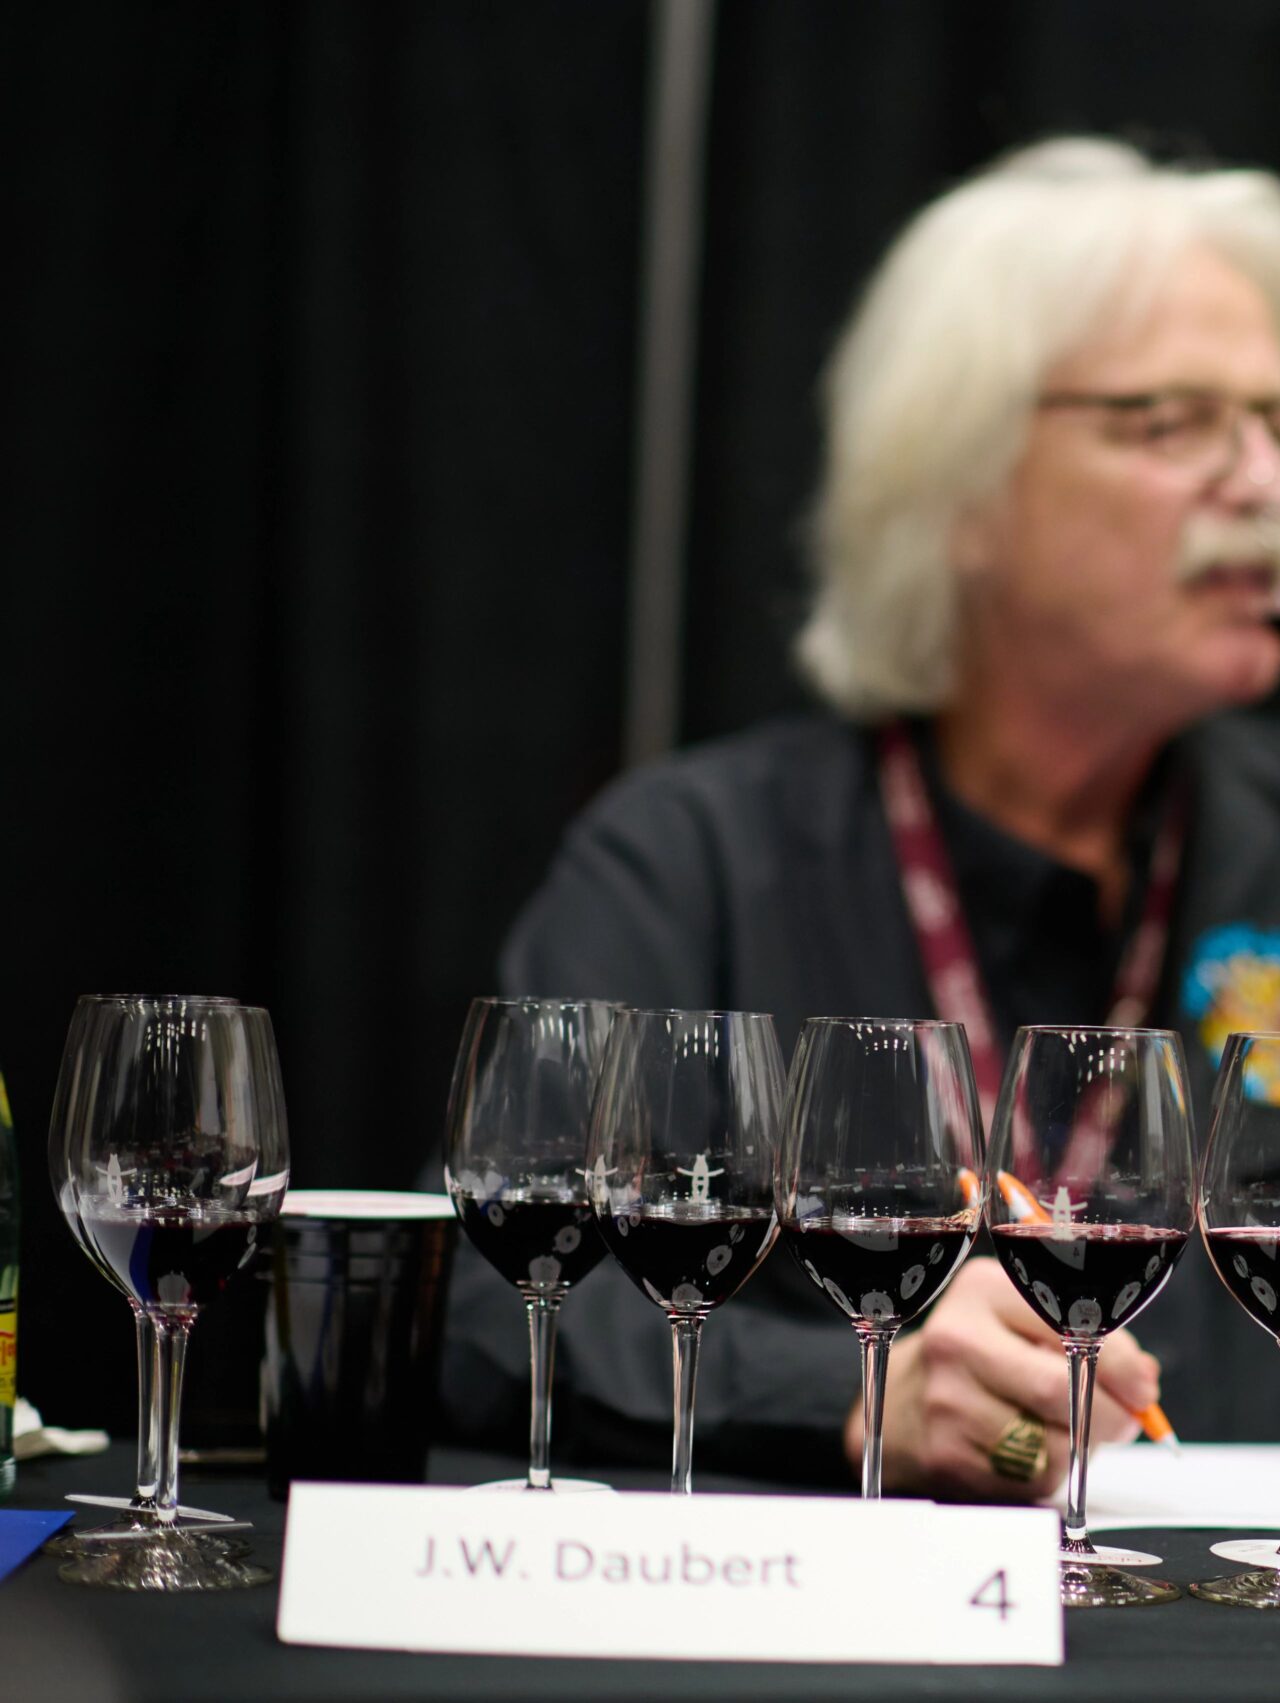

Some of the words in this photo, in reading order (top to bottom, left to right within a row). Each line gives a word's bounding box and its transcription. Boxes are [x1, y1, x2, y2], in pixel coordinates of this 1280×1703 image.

[416, 1535, 528, 1580] J.W.
[554, 1539, 801, 1588] Daubert
[967, 1567, 1017, 1622] 4
